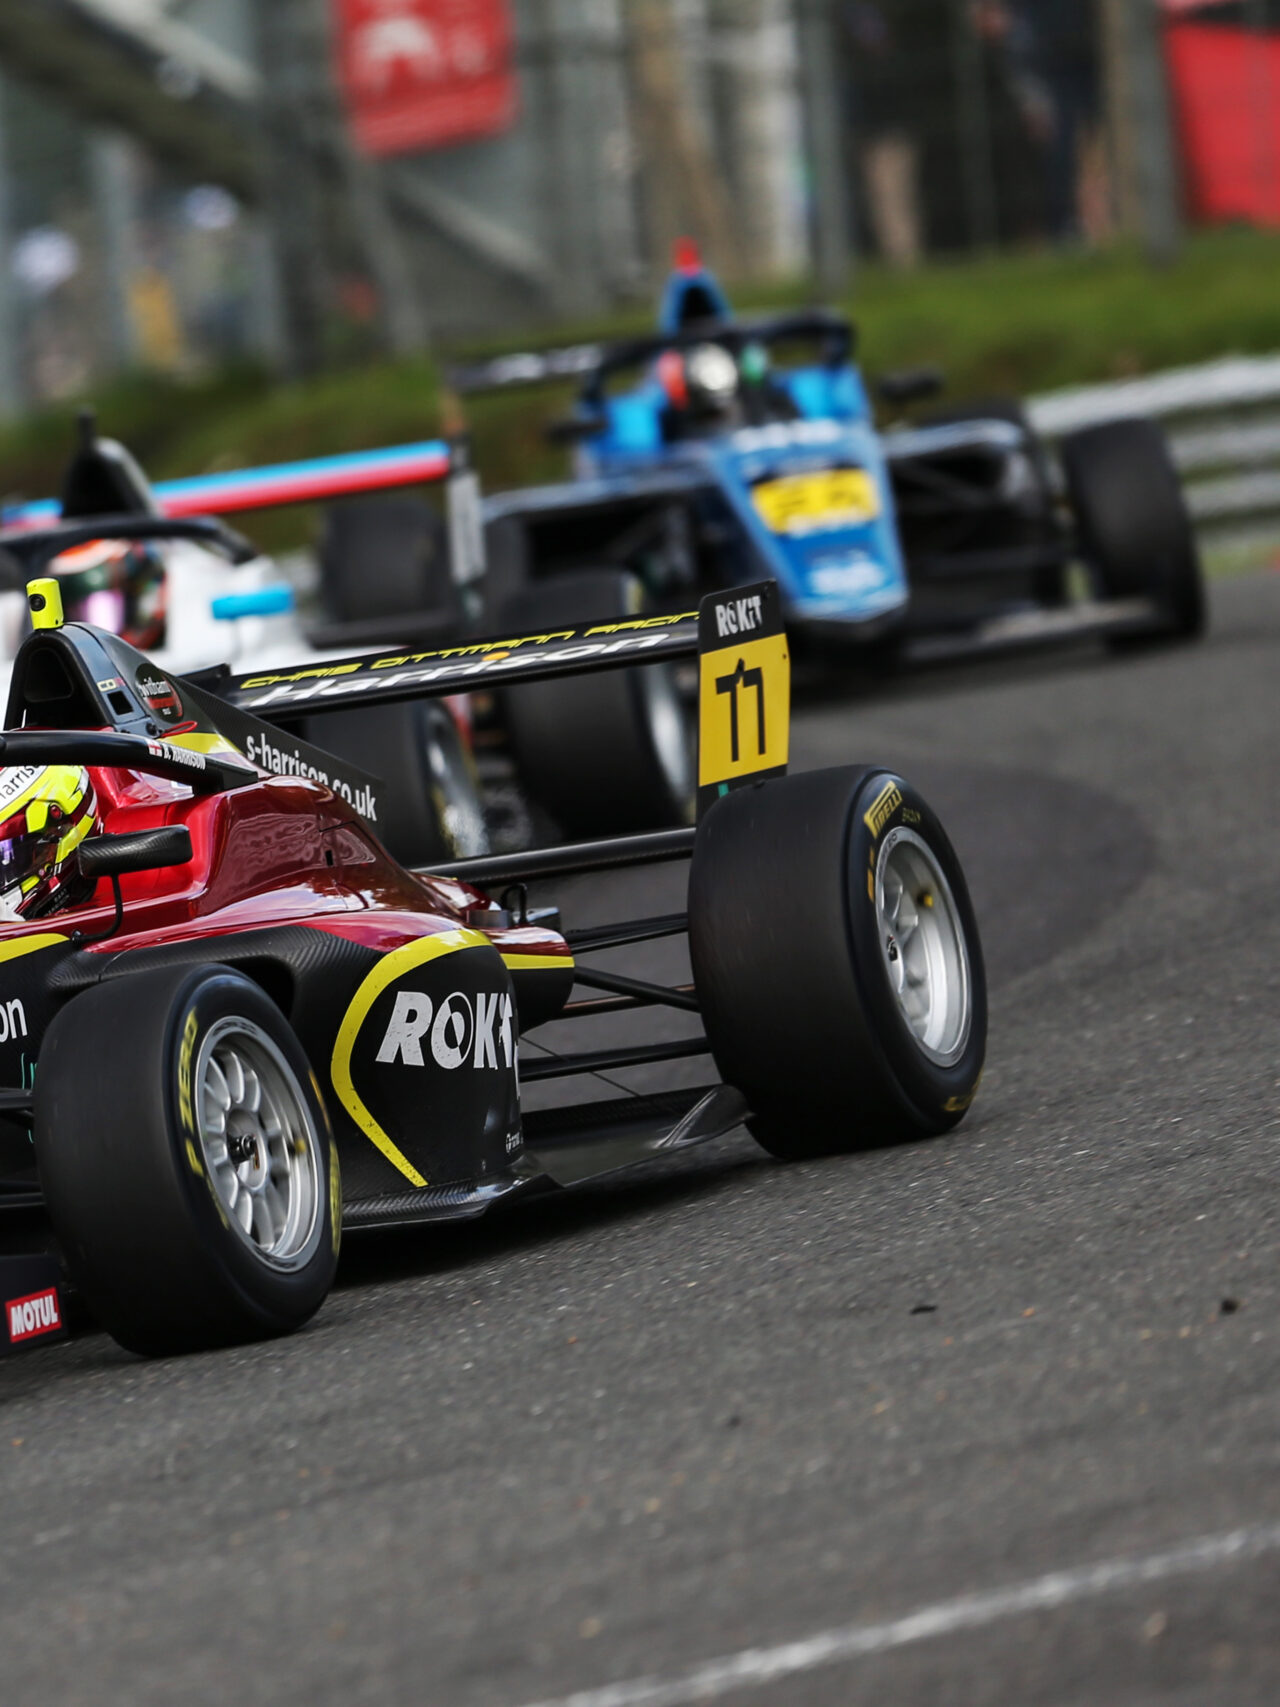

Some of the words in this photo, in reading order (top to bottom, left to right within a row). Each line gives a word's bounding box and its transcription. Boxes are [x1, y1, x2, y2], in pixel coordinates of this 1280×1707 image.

[240, 663, 363, 689] CHRIS
[370, 630, 576, 669] DITTMANN
[584, 611, 700, 637] RACIN
[249, 631, 669, 707] Harrison
[715, 663, 766, 762] 77
[864, 781, 903, 839] PIRELLI
[10, 1294, 59, 1337] MOTUL
